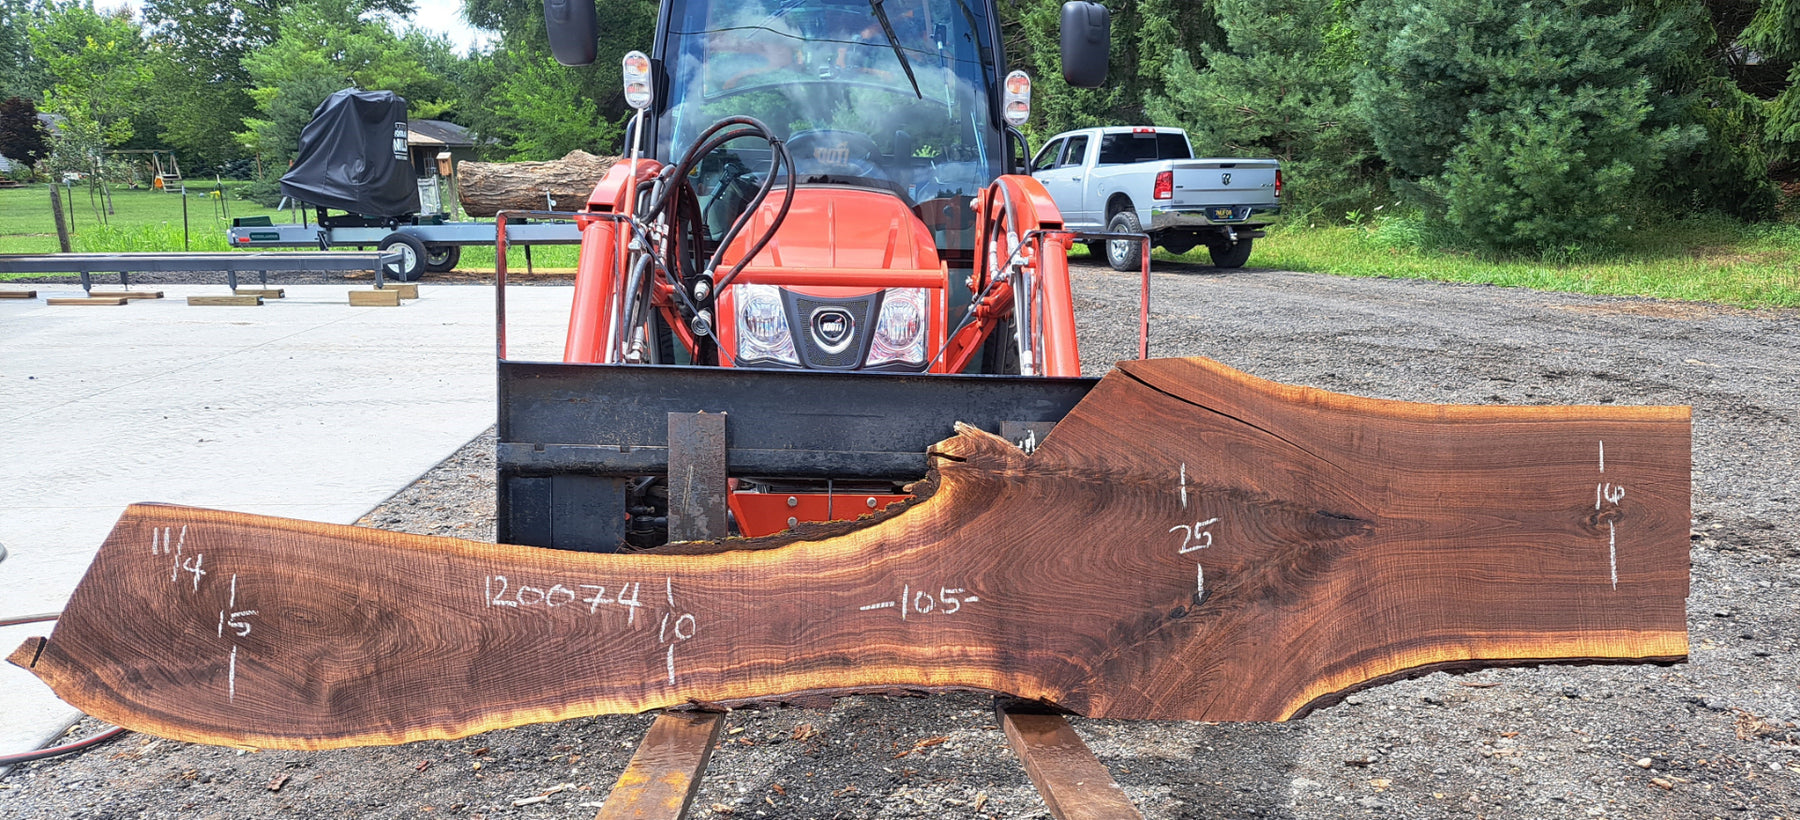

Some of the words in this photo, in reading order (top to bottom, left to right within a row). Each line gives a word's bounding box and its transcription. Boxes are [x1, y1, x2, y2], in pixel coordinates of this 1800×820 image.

[1595, 482, 1626, 511] 16
[1168, 516, 1222, 554] 25
[484, 575, 643, 626] 120074
[218, 609, 259, 638] 15
[659, 612, 696, 643] 10
